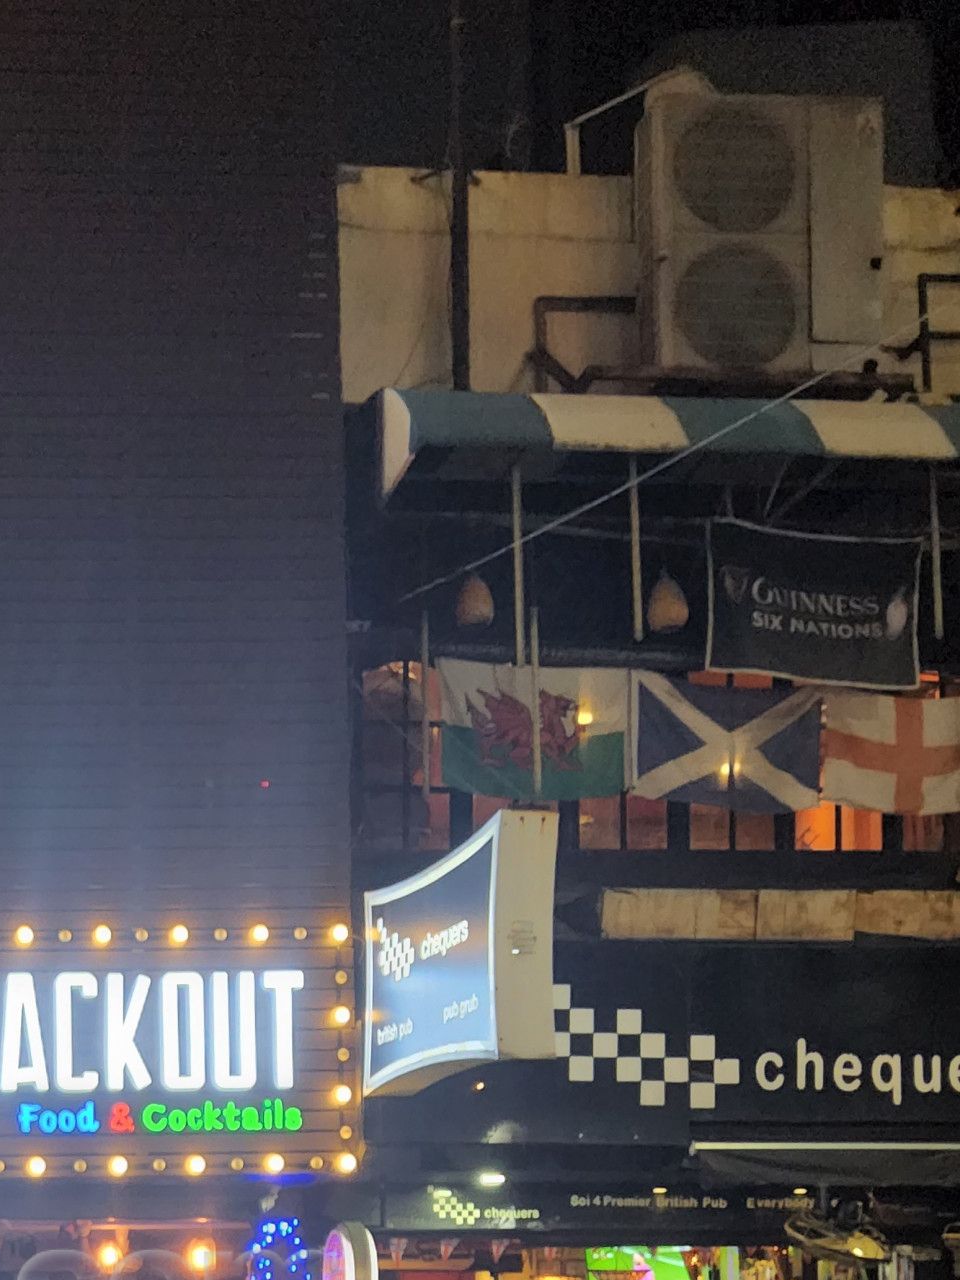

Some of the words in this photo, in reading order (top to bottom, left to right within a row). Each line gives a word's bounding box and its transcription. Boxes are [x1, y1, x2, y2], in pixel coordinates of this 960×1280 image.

[751, 577, 880, 616] GUINNESS
[751, 610, 783, 631] SIX
[790, 617, 883, 640] NATIONS
[420, 920, 469, 960] chequers
[443, 1001, 459, 1024] pub
[460, 993, 479, 1019] grub
[399, 1017, 413, 1040] pub
[18, 1102, 100, 1134] Food
[110, 1101, 134, 1133] &
[142, 1099, 303, 1133] Cocktails
[484, 1207, 540, 1220] chequers
[592, 1195, 601, 1207] 4
[702, 1196, 728, 1209] Pub
